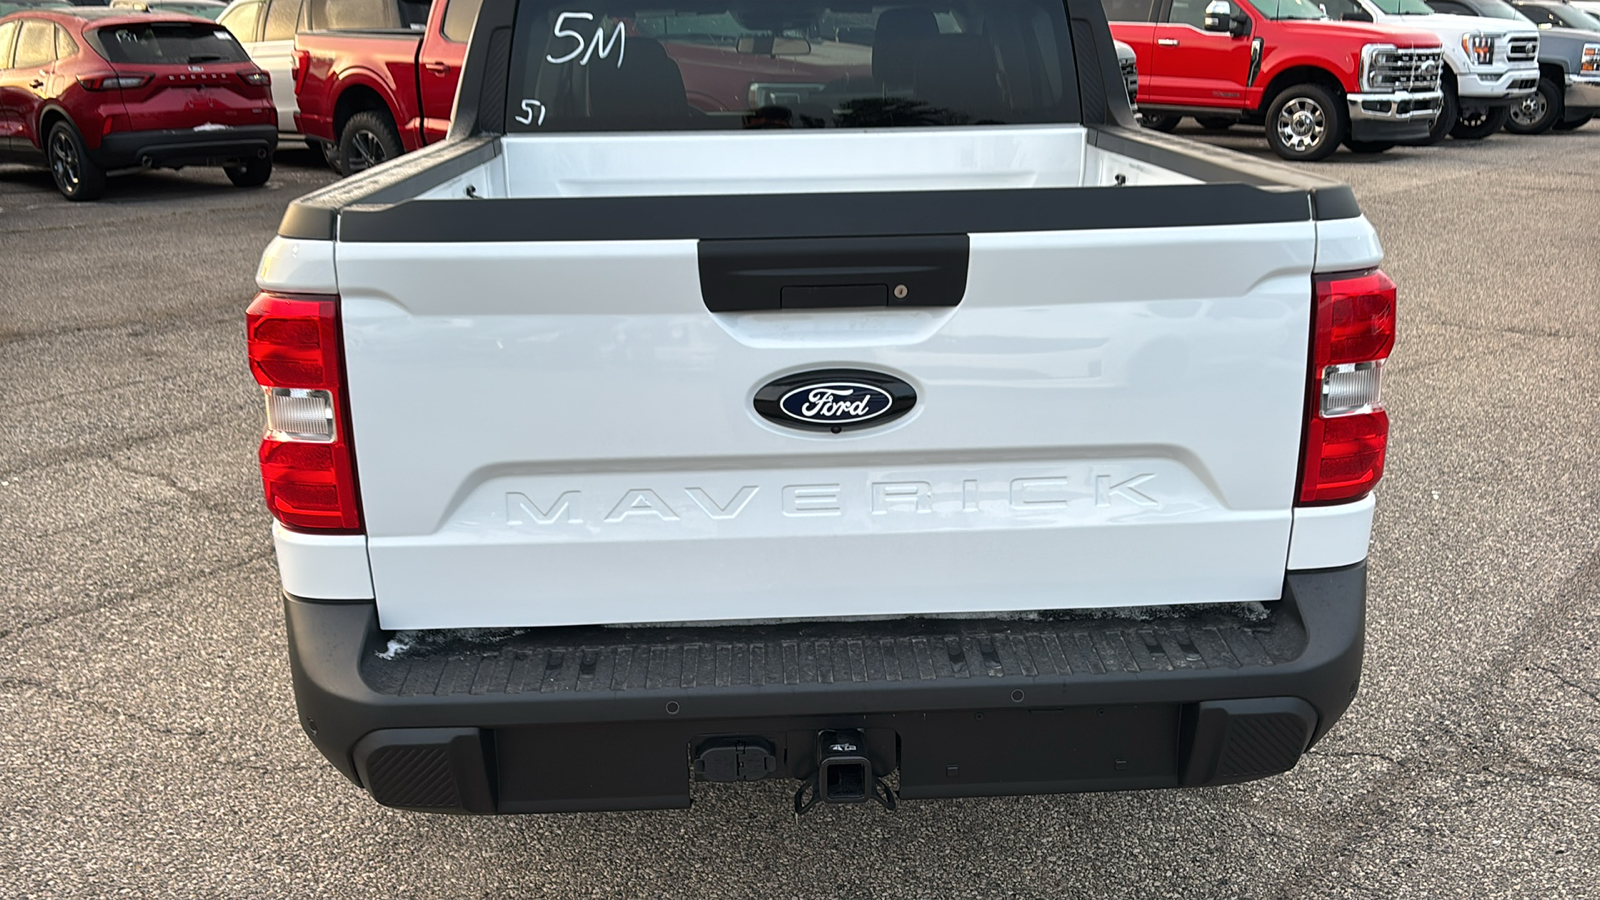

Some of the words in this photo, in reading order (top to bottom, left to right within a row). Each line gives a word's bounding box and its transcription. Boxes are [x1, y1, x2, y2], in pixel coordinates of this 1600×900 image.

[546, 12, 625, 68] 5M
[801, 388, 870, 417] Ford
[505, 472, 1159, 526] MAVERICK
